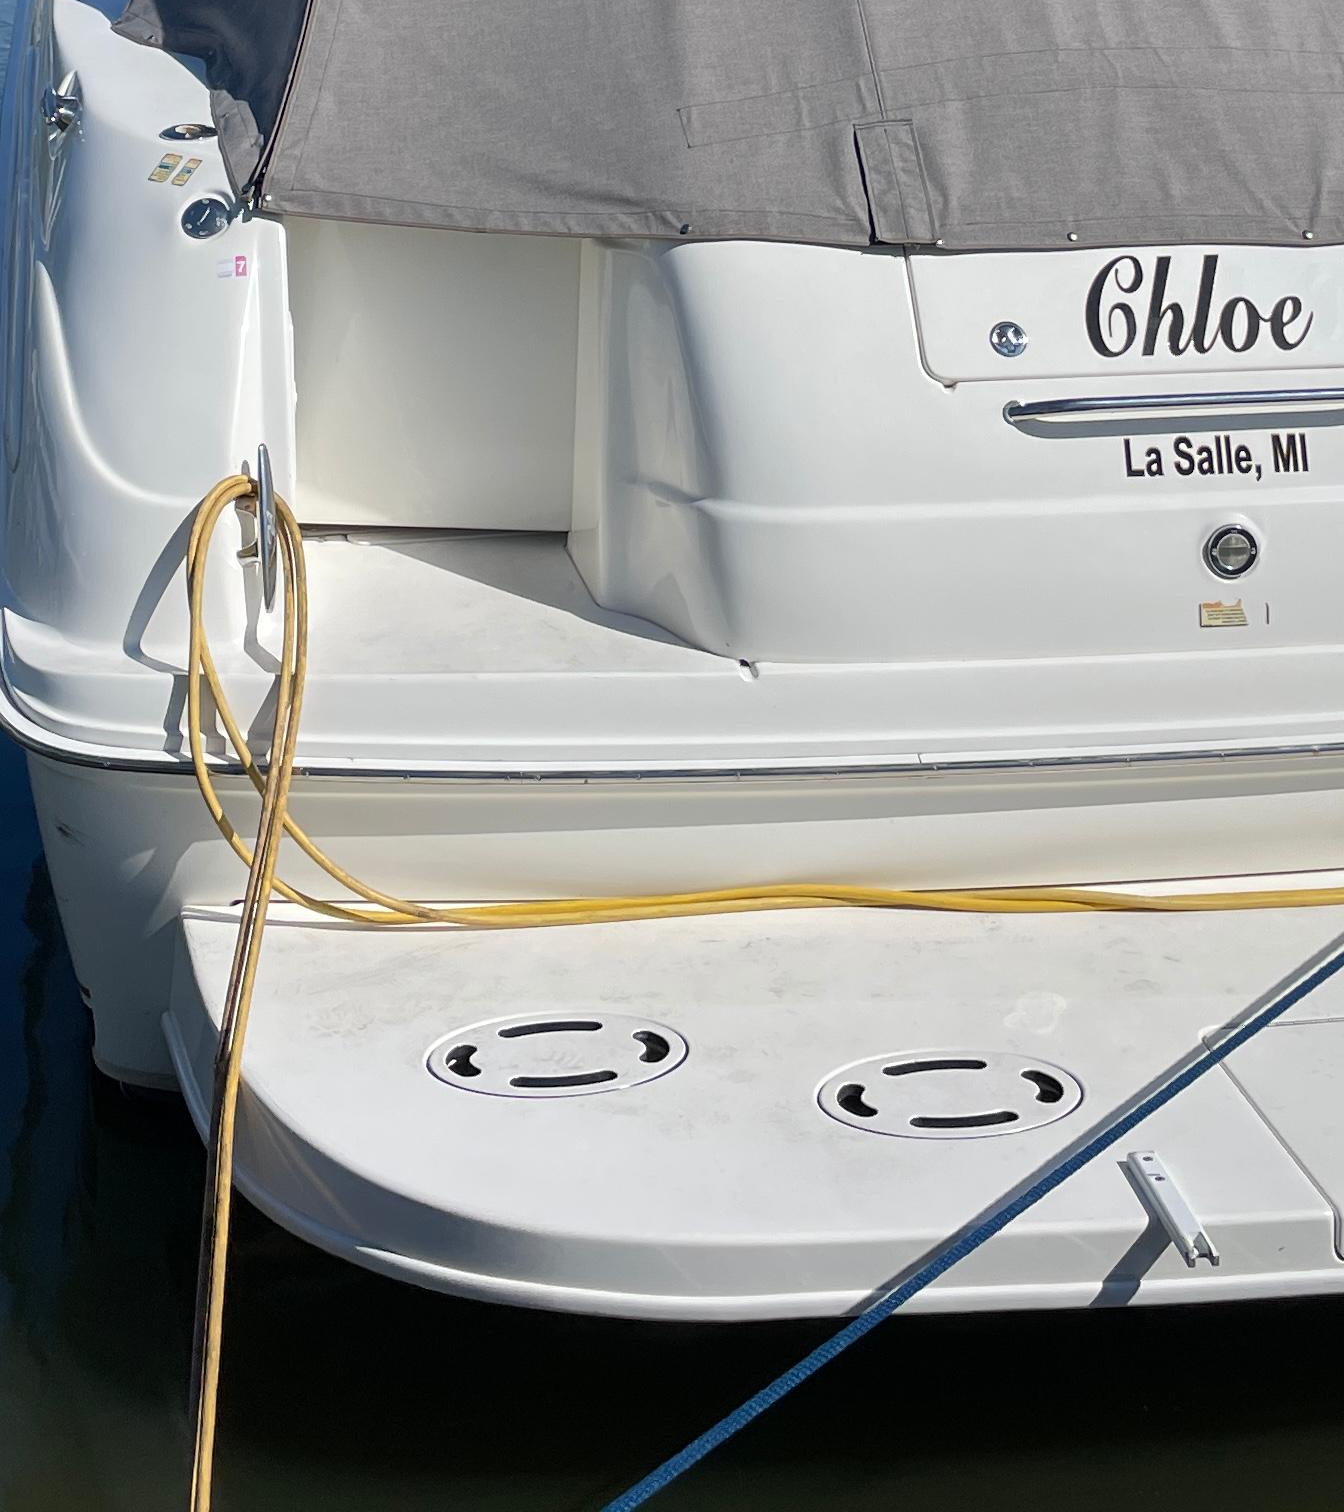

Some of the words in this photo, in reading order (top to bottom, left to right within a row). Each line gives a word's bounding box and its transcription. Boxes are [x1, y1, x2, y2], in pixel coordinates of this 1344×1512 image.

[236, 260, 246, 273] 7
[1085, 254, 1314, 358] Chloe
[1123, 437, 1164, 477] La
[1173, 434, 1262, 482] Salle,
[1270, 432, 1310, 473] MI
